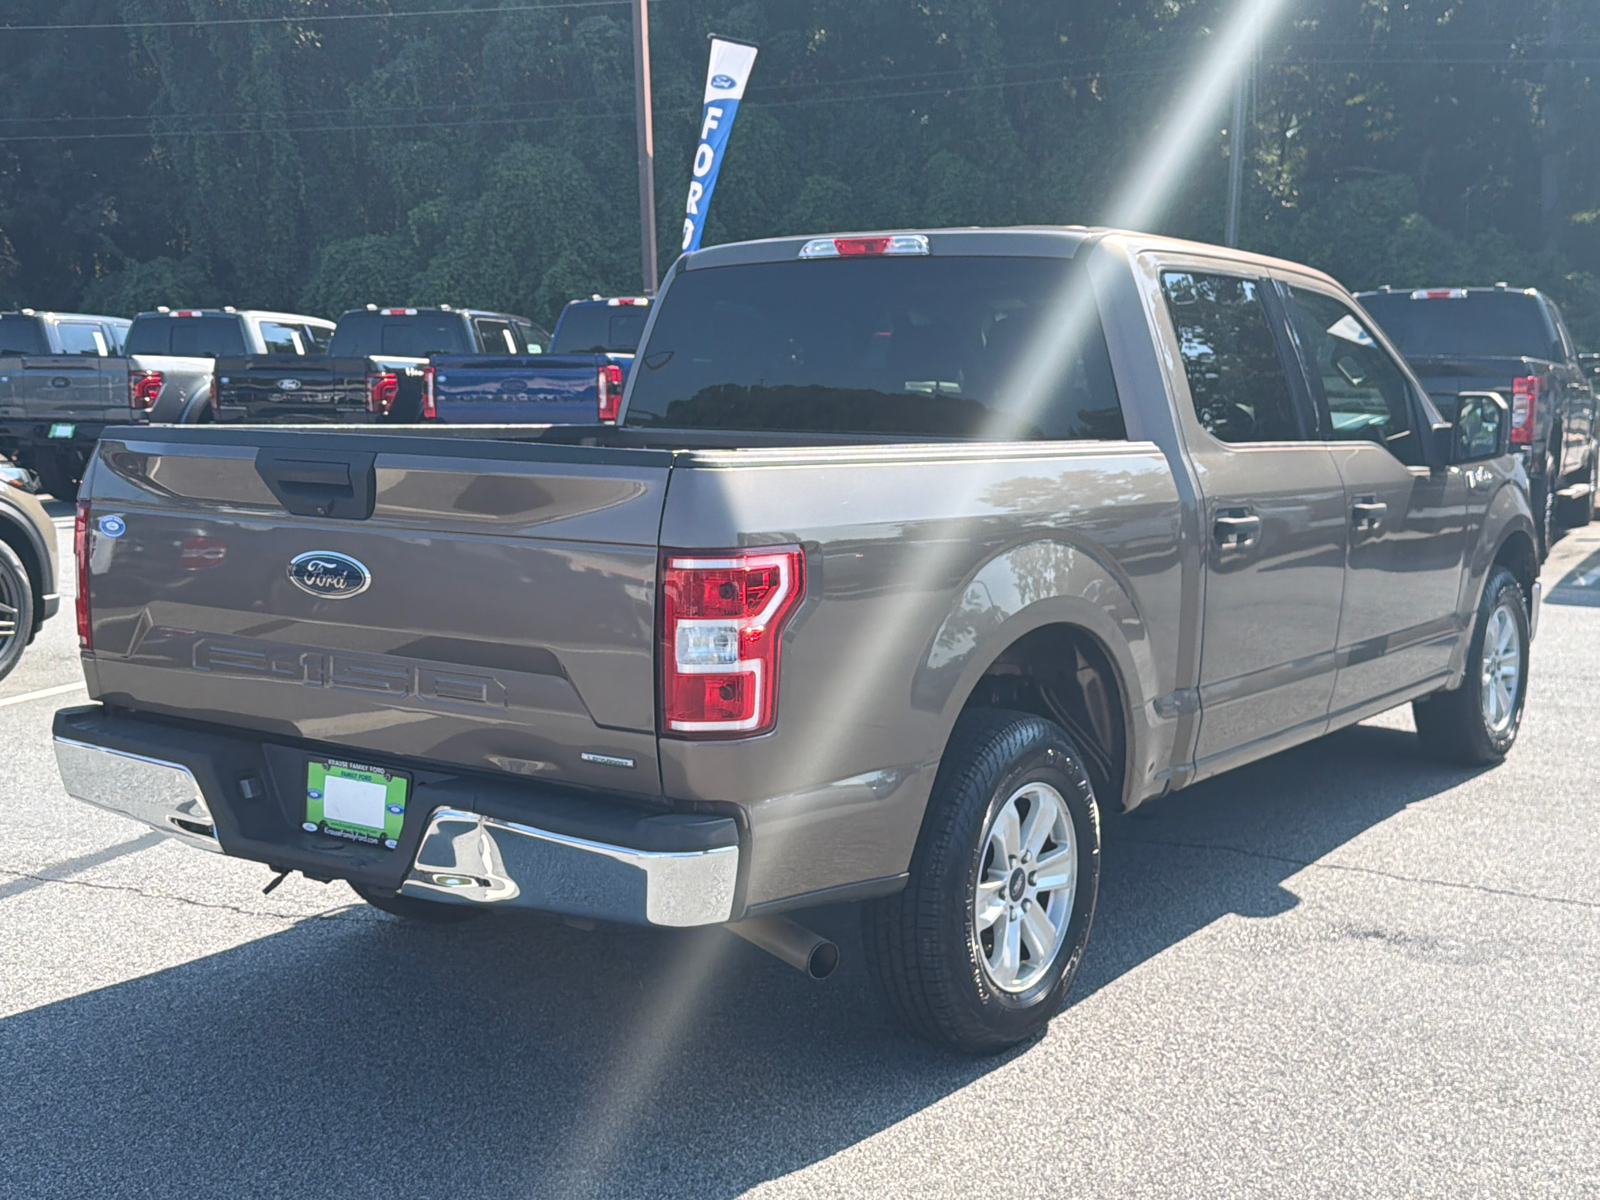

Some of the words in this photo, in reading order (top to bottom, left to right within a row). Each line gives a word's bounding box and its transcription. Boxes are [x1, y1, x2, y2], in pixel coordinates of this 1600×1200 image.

[682, 106, 723, 250] FORD
[304, 560, 348, 589] Ford
[192, 638, 508, 712] F-150
[328, 759, 348, 768] KRAUSE
[349, 762, 369, 772] FAMILY
[369, 766, 386, 775] FORD
